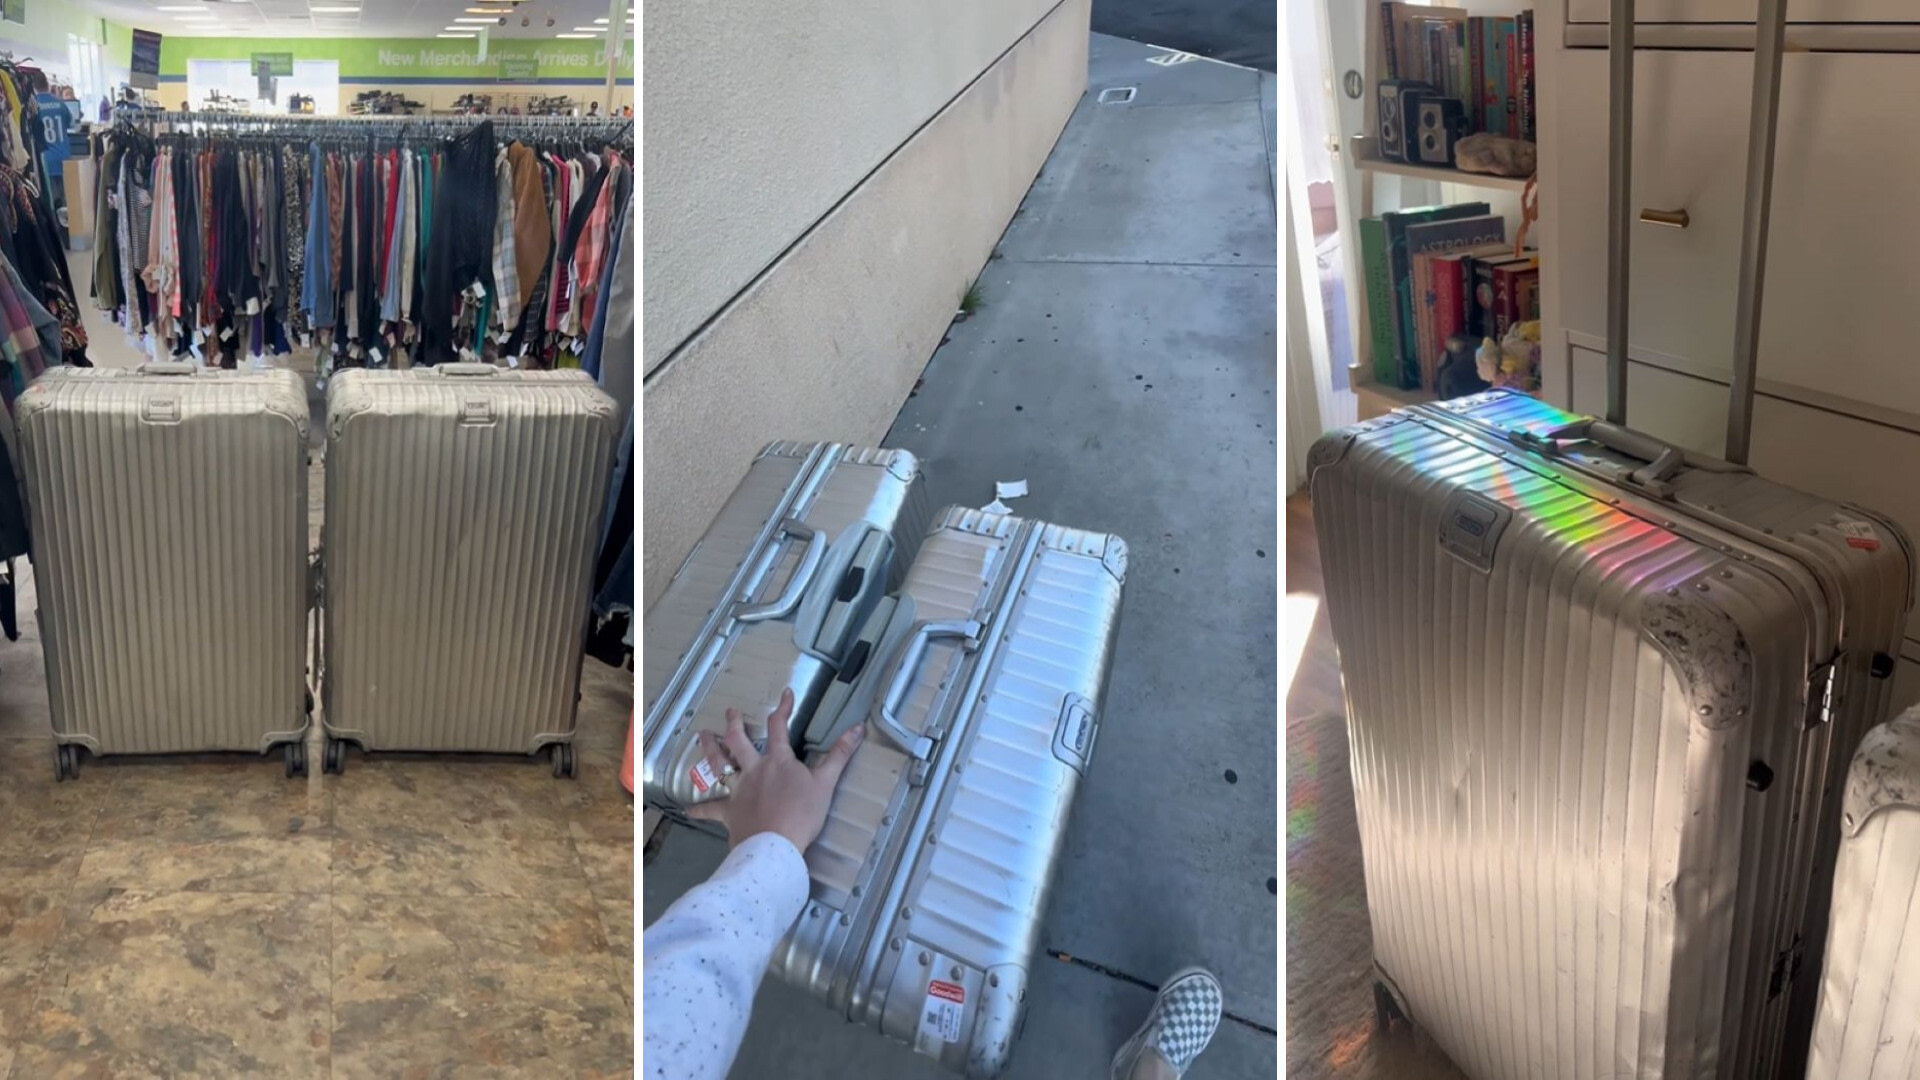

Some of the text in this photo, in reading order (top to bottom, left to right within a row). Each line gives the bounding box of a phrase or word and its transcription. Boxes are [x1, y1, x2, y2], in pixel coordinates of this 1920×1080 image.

[378, 49, 415, 66] New
[533, 49, 588, 66] Arrives
[594, 50, 634, 71] Dily
[42, 115, 64, 143] 81
[1421, 234, 1502, 252] ASTROLOGY
